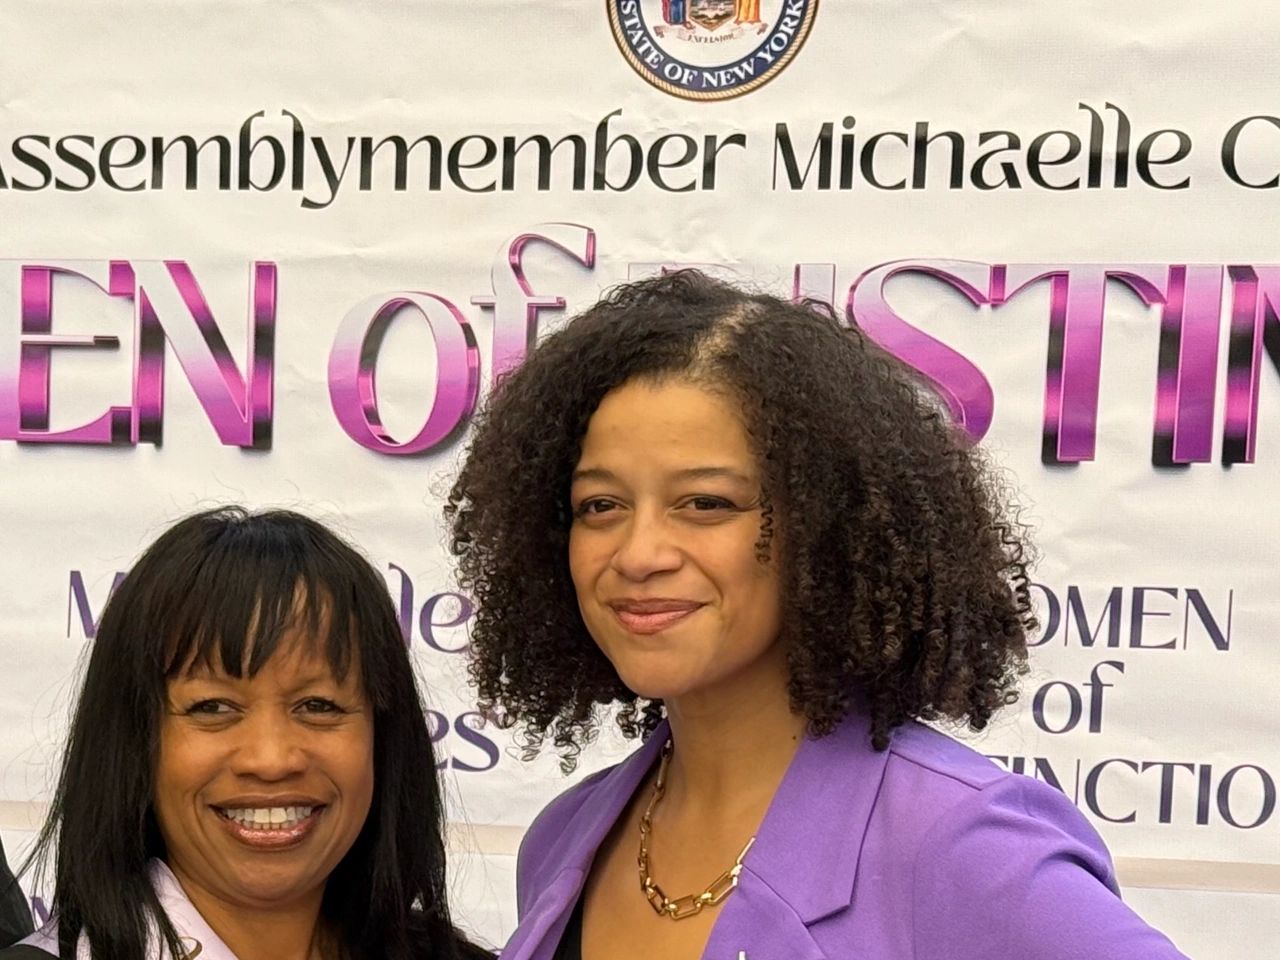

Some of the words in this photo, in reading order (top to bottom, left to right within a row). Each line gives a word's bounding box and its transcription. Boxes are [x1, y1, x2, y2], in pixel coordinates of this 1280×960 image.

[621, 0, 664, 69] STATE
[664, 63, 698, 85] OF
[702, 58, 756, 88] NEW
[756, 0, 805, 64] YORK
[772, 102, 1192, 191] Michaelle
[328, 222, 596, 455] of
[1032, 660, 1125, 734] of
